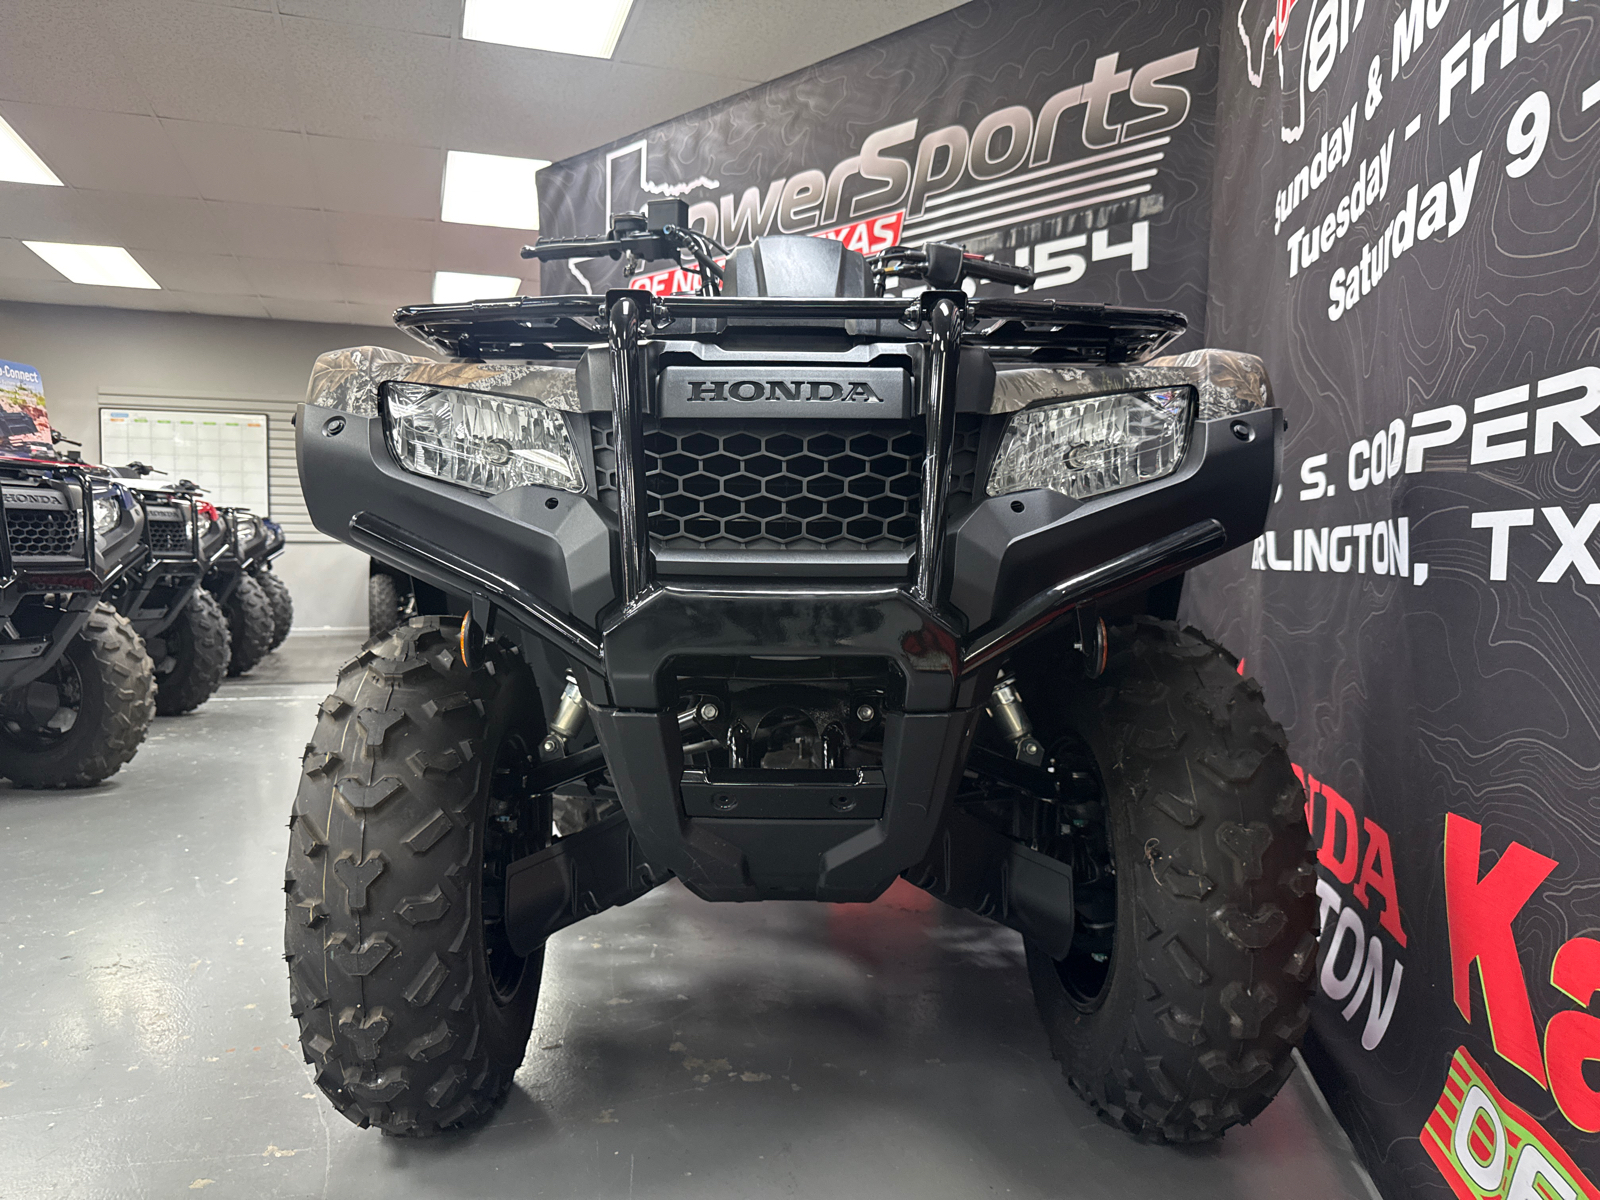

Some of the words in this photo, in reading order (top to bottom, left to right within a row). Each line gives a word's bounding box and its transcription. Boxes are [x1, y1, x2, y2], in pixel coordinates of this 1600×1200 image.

[1364, 55, 1383, 121] &
[636, 47, 1199, 272] owerSports
[1287, 128, 1395, 278] Tuesday
[1328, 150, 1483, 321] Saturday
[1505, 90, 1550, 179] 9
[687, 381, 885, 403] HONDA
[1300, 453, 1335, 501] S.
[1348, 366, 1600, 492] COOPER
[2, 493, 63, 505] HONDA
[1471, 502, 1600, 585] TX
